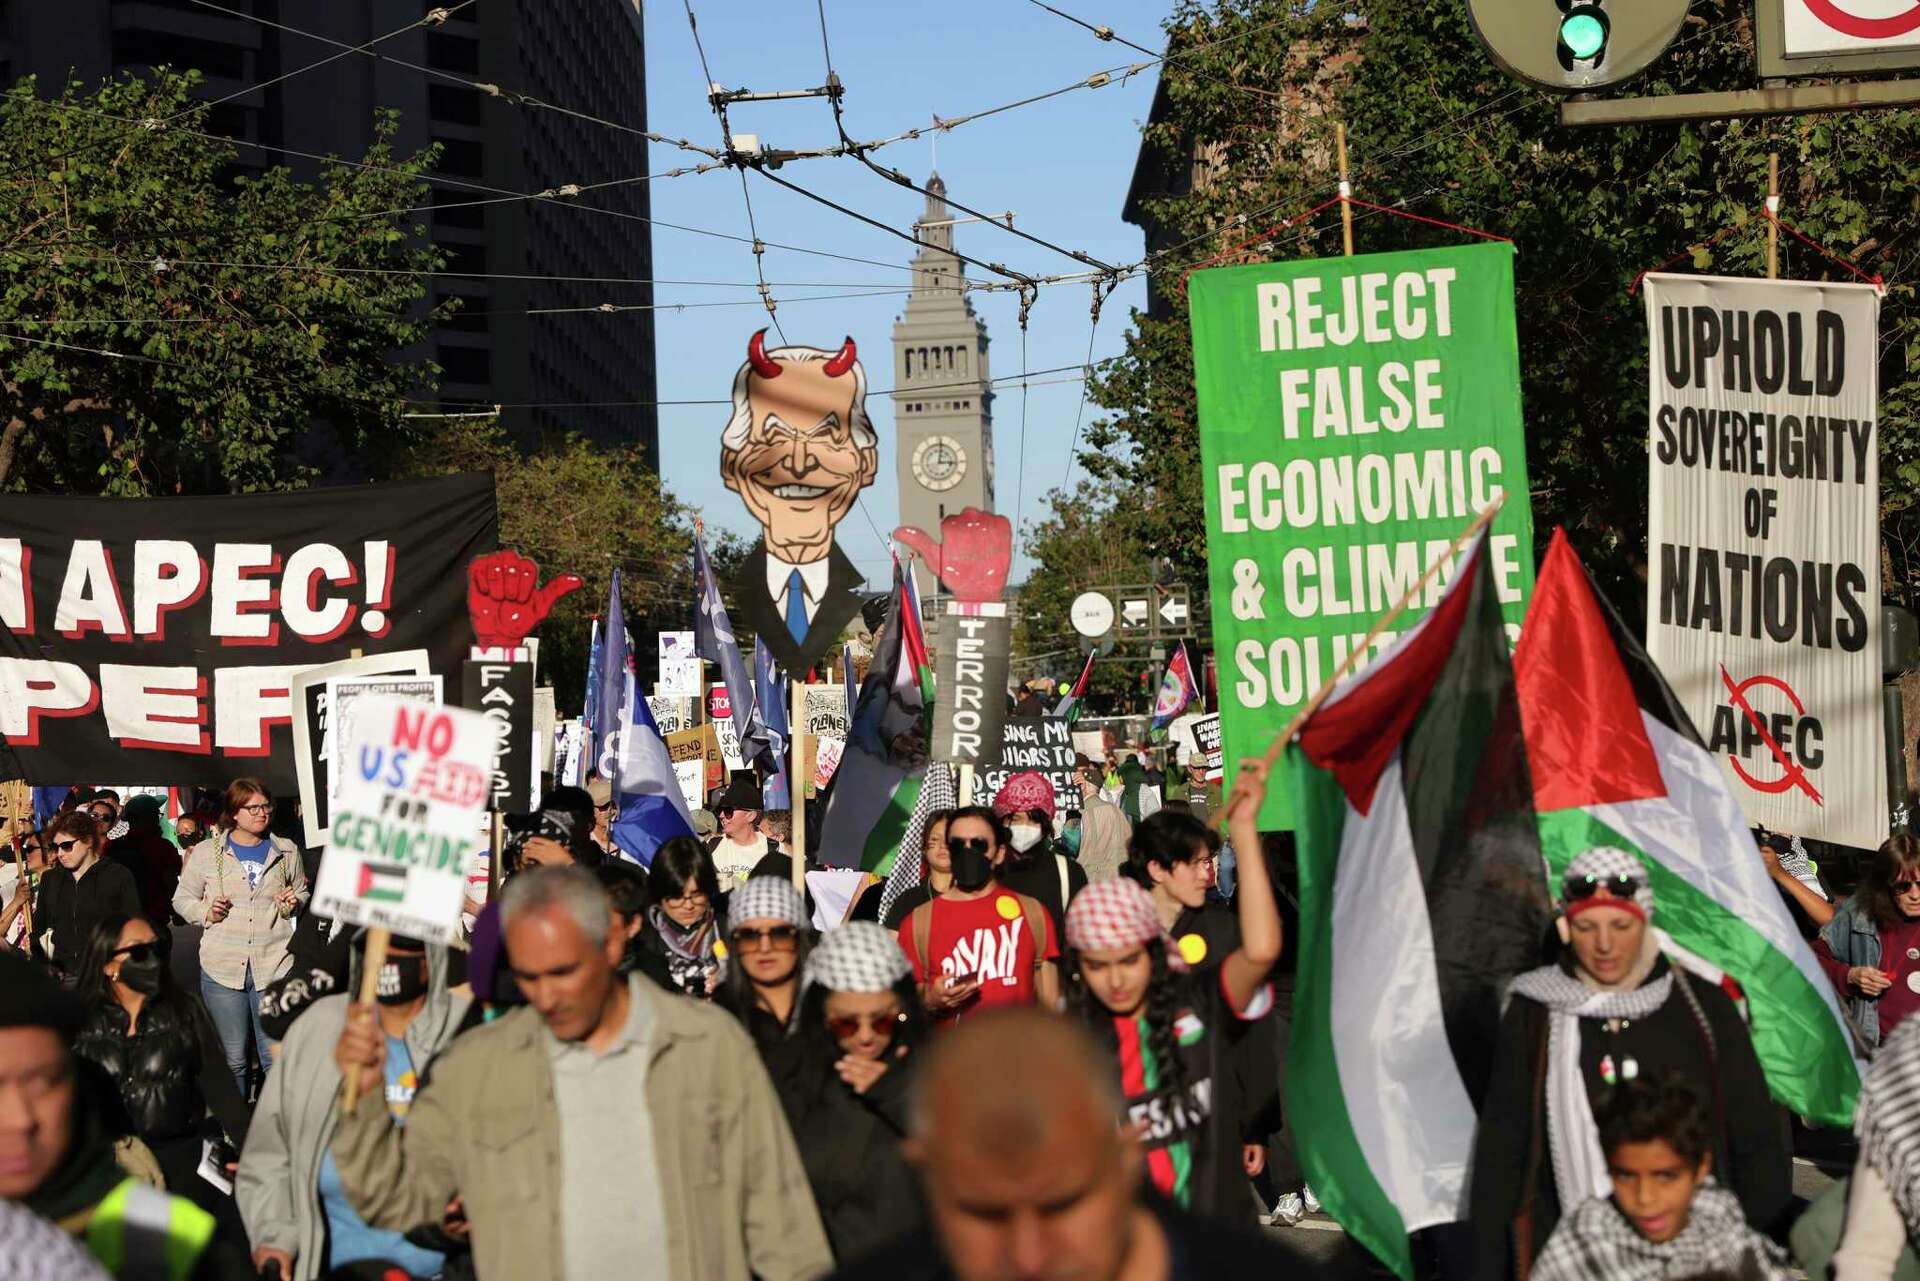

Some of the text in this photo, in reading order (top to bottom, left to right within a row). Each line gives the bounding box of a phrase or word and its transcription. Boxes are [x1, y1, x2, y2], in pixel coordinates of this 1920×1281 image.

[1257, 267, 1456, 353] REJECT
[1661, 305, 1846, 398] UPHOLD
[1280, 359, 1445, 439] FALSE
[1656, 403, 1872, 485] SOVEREIGNTY
[1218, 446, 1504, 533] ECONOMIC
[1744, 487, 1778, 540] OF
[54, 539, 394, 643] APEC!
[1231, 534, 1522, 621] & CLIMAE
[1660, 542, 1868, 653] NATIONS
[810, 713, 848, 735] PLANET
[951, 619, 987, 757] TERROR
[358, 742, 410, 789] US
[391, 704, 455, 759] NO
[1043, 720, 1070, 745] MY
[1052, 744, 1077, 767] TO
[1710, 704, 1825, 770] APEC
[333, 810, 472, 876] GENOCIDE
[380, 794, 429, 823] FOR
